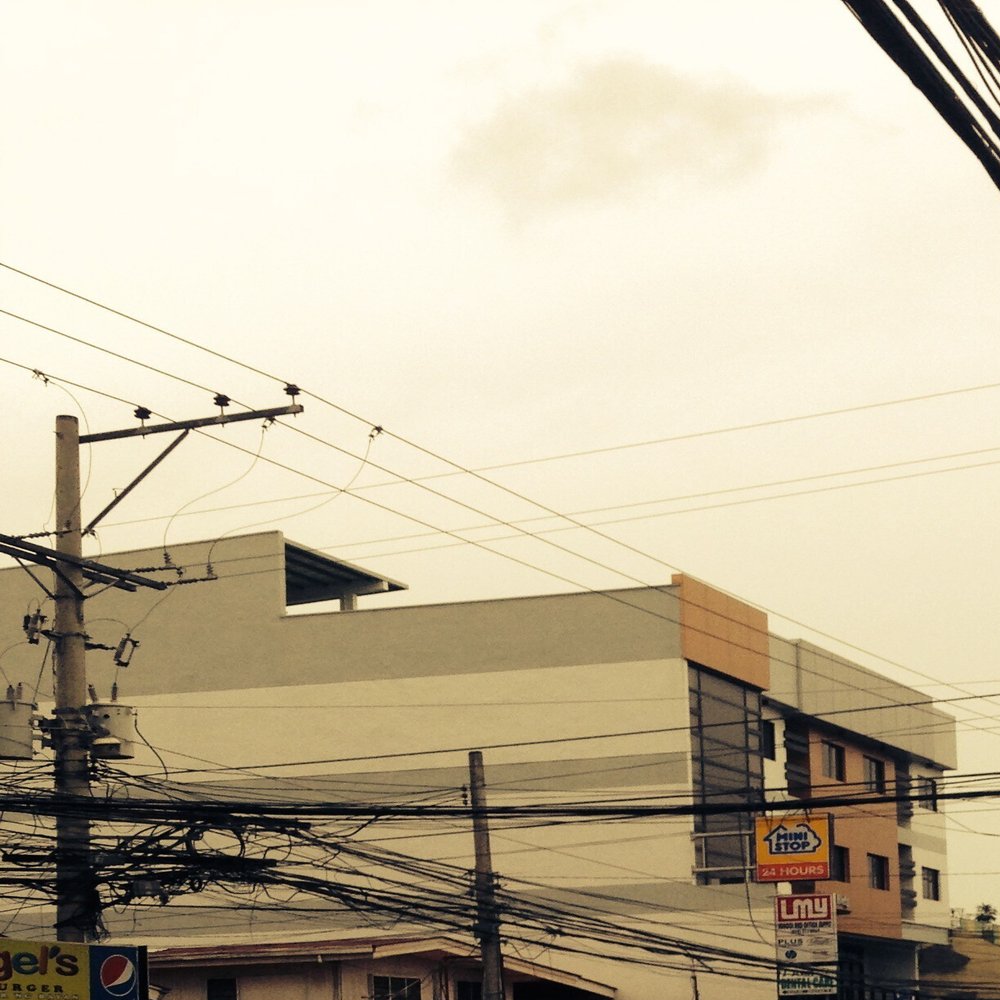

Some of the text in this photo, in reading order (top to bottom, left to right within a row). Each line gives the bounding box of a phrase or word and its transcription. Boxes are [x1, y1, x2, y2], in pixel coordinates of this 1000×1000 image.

[777, 832, 807, 841] MINI
[775, 841, 810, 851] STOP
[761, 865, 824, 877] 24 HOURS
